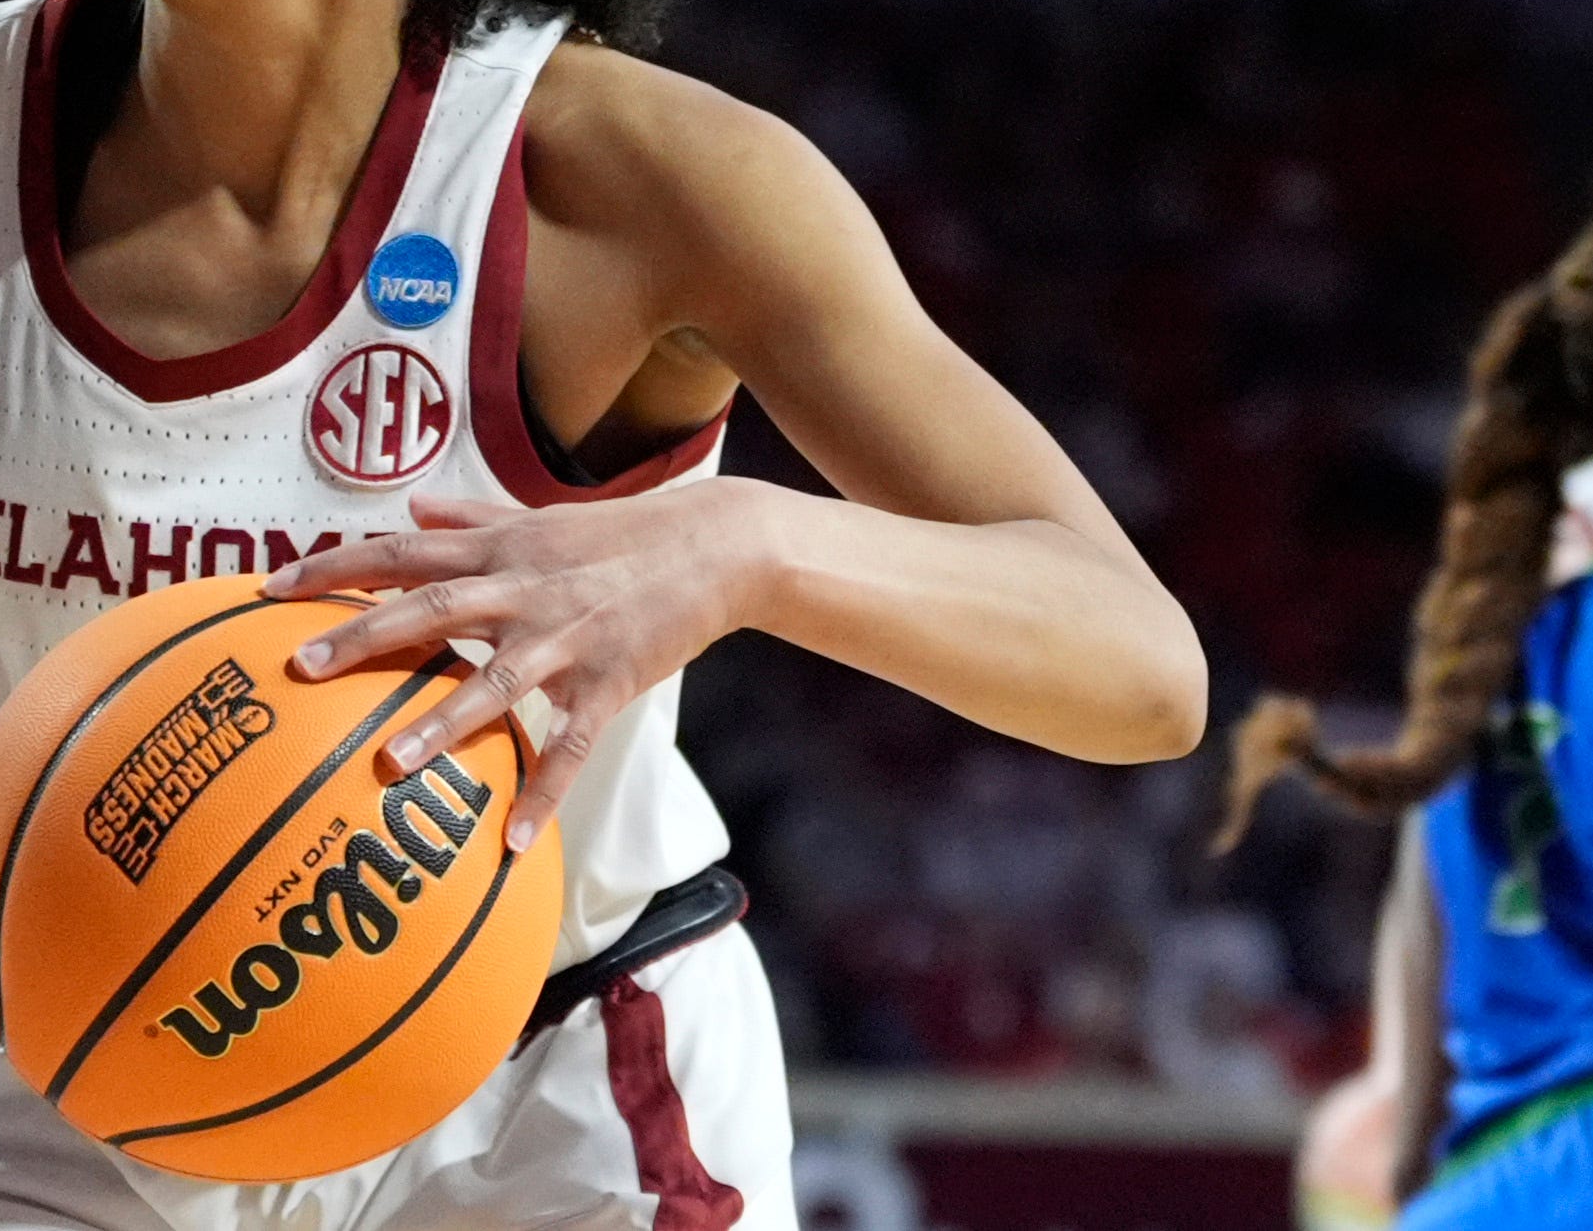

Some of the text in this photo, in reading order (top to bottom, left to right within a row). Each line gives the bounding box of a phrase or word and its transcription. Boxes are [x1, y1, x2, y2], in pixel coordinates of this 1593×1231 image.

[378, 276, 452, 304] NCAA
[317, 351, 444, 475] SEC
[89, 708, 209, 849] MADNESS
[146, 719, 246, 826] MARCH
[157, 751, 493, 1059] Wilson
[254, 816, 348, 923] EVO NXT
